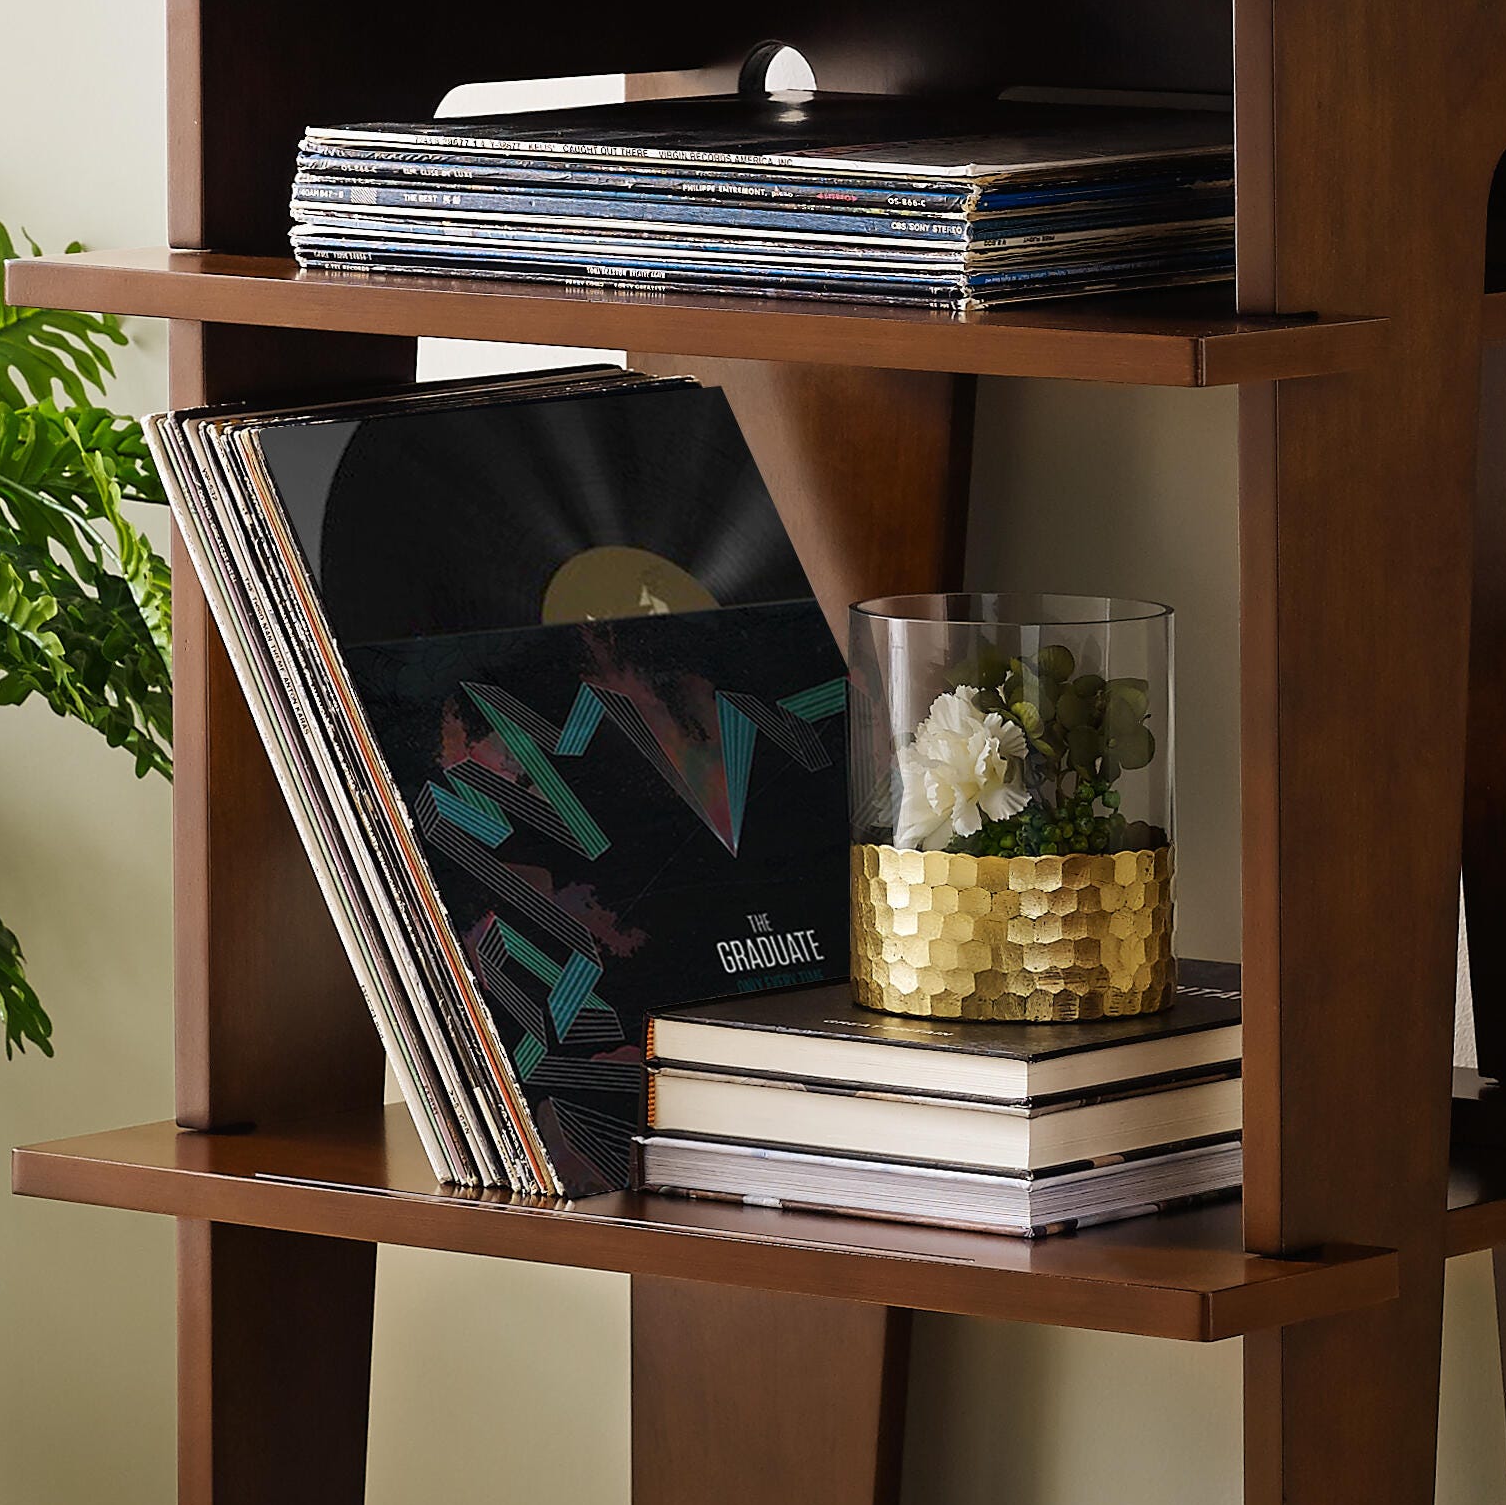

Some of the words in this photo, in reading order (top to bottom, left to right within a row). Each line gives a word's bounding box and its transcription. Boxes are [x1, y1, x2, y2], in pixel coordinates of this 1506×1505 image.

[562, 145, 598, 155] CAUGHT
[600, 147, 617, 156] OUT
[622, 147, 648, 158] THERE
[658, 150, 687, 160] VIRGIN
[690, 151, 731, 162] RECORDS
[404, 193, 417, 202] THE
[419, 194, 437, 203] BEST
[932, 225, 963, 235] STEREO
[243, 576, 253, 592] THE
[250, 596, 265, 620] THIRD
[261, 621, 274, 642] MAN
[282, 675, 298, 705] ANTON
[294, 705, 310, 735] KARAS
[747, 913, 774, 934] THE
[716, 929, 825, 973] GRADUATE
